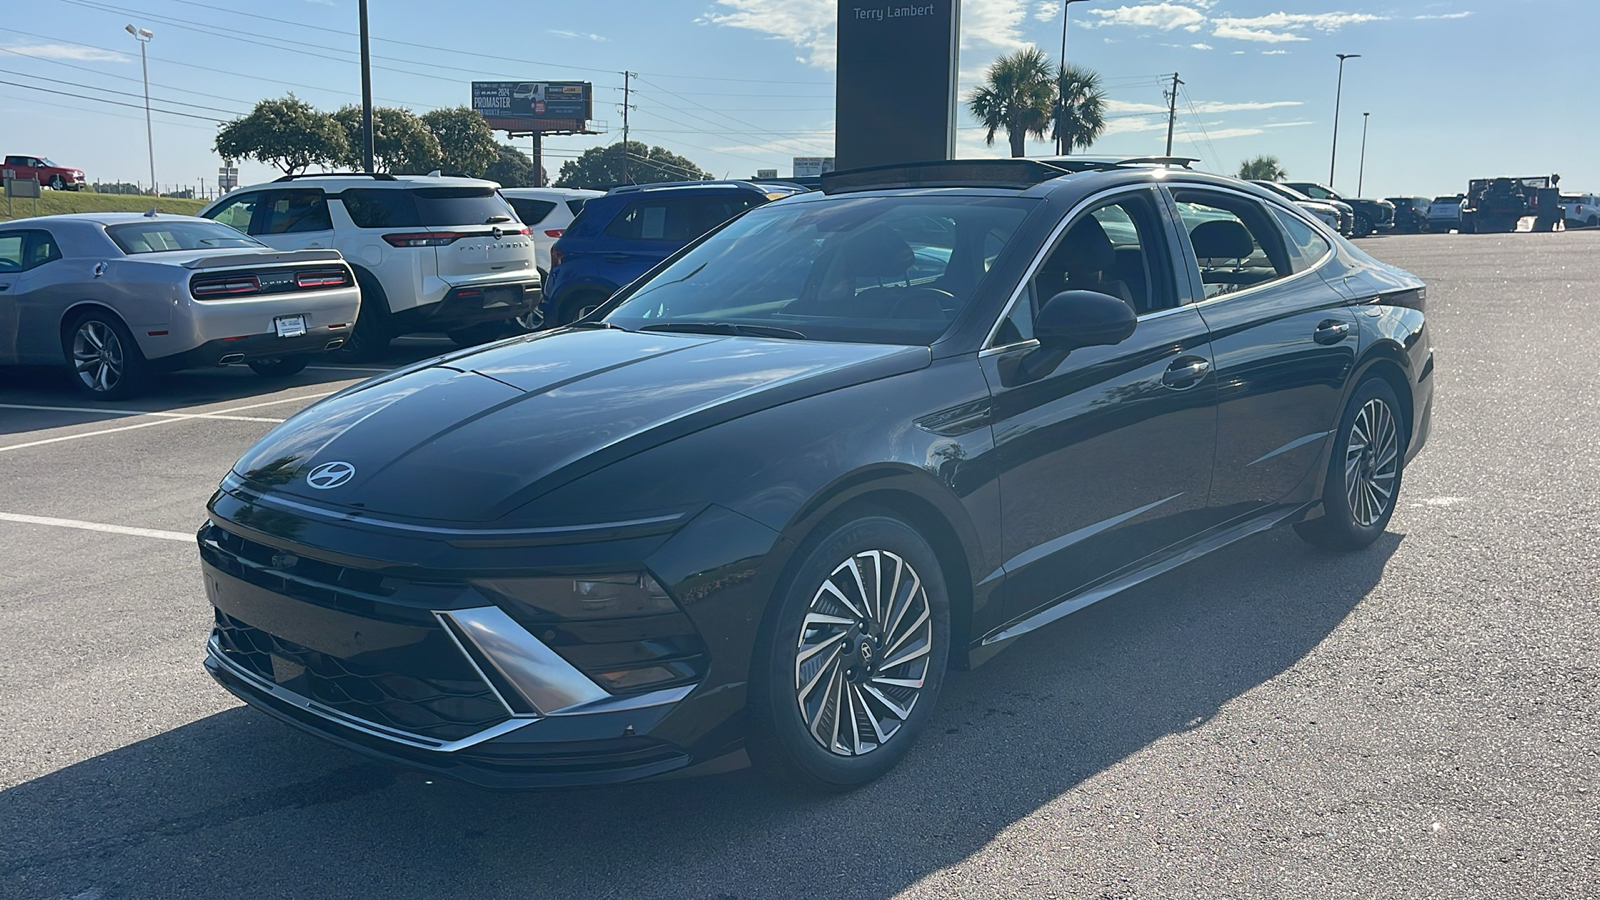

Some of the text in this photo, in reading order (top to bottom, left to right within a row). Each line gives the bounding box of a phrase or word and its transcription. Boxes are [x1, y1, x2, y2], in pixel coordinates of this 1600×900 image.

[854, 4, 934, 21] Terry Lambert
[498, 88, 510, 96] 2024
[474, 97, 510, 108] PROMASTER
[460, 242, 529, 251] PATHFINDER
